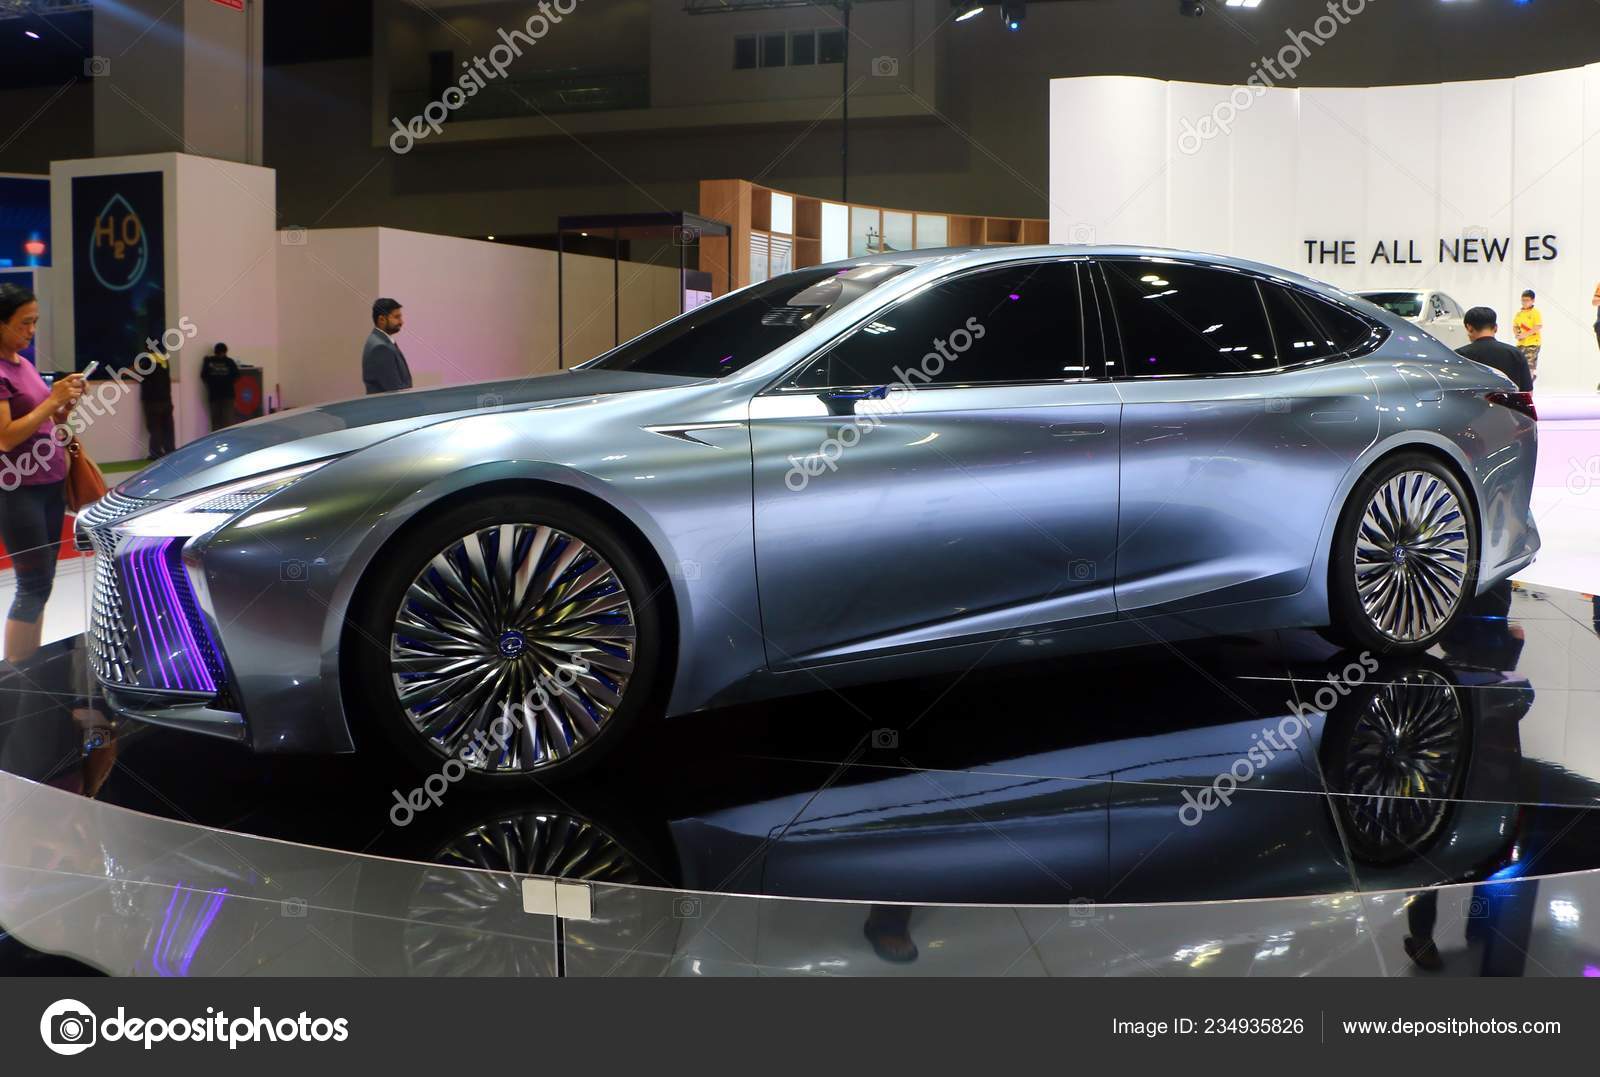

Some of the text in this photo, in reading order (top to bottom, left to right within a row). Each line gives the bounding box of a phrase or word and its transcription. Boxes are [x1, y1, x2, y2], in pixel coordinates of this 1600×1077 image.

[96, 214, 141, 259] H2O
[1304, 235, 1558, 264] THE ALL NEW ES
